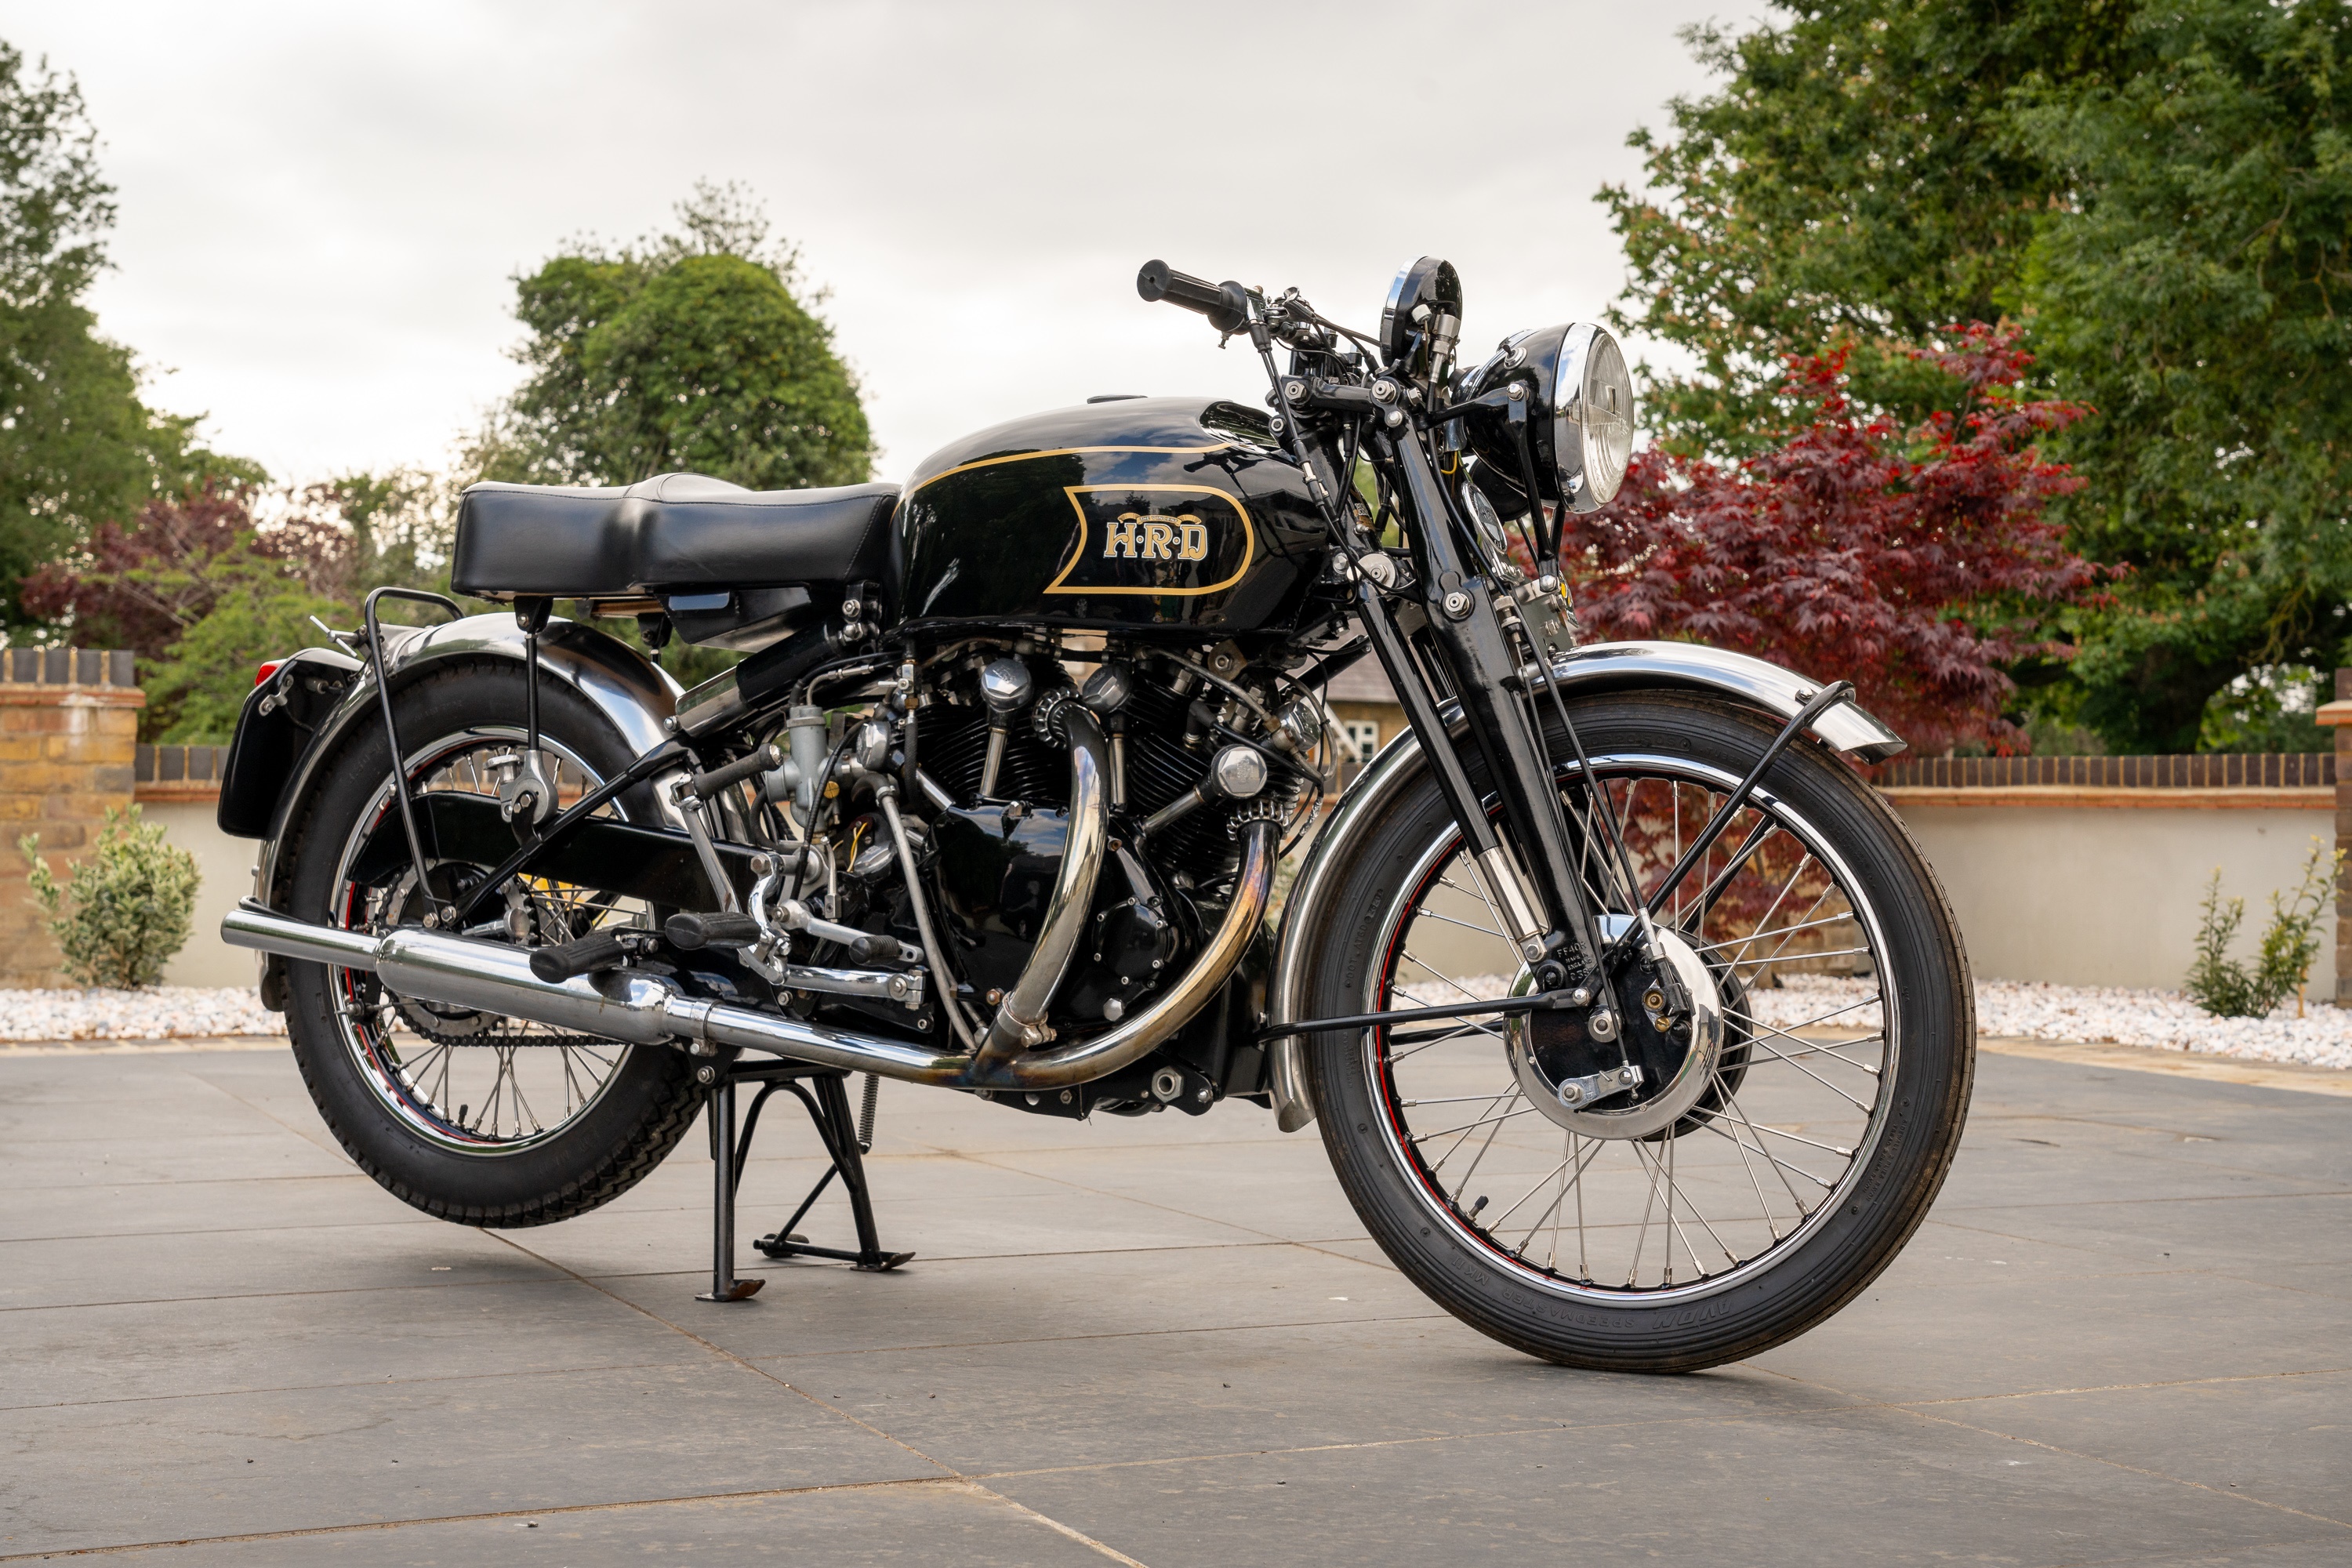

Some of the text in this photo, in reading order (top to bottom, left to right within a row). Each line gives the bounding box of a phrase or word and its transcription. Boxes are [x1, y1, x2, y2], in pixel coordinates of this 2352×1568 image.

[1567, 957, 1592, 971] ENGLAND
[1891, 1118, 1907, 1152] SIDEWALL
[1864, 1180, 1881, 1202] RAYON
[1502, 1287, 1634, 1327] SPEEDMASTER
[1651, 1297, 1734, 1328] AVON
